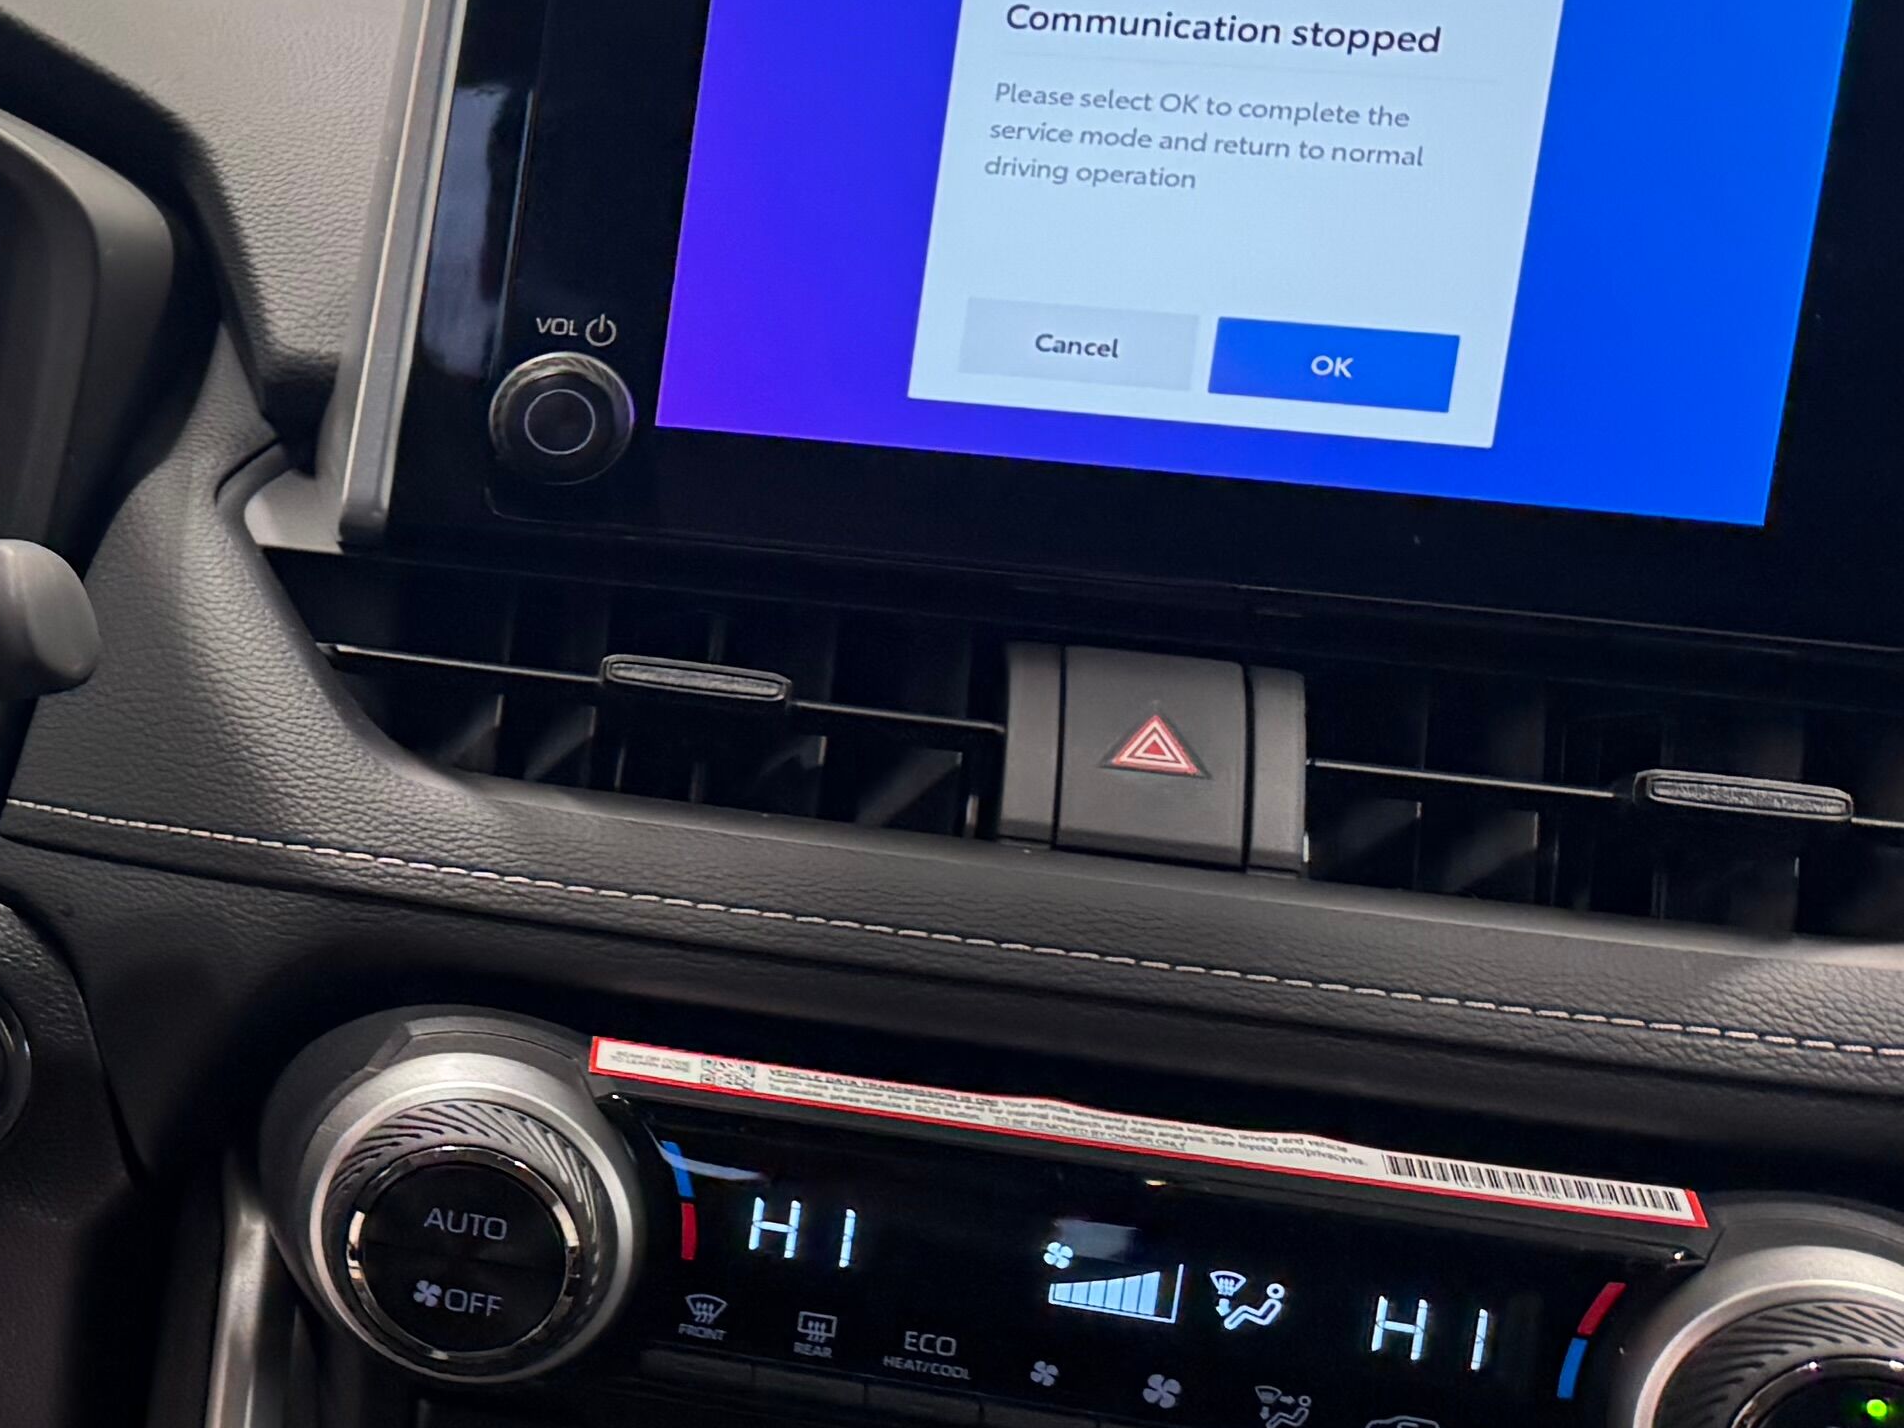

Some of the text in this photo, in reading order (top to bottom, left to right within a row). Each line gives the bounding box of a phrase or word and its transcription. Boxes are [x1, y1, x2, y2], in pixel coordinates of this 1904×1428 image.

[1006, 3, 1442, 57] Communication stopped
[995, 82, 1410, 128] Please select OK to complete the
[990, 121, 1425, 168] service mode and return to normal
[984, 155, 1197, 189] driving operation
[536, 316, 578, 337] VOL
[1033, 331, 1120, 361] Cancel
[1309, 355, 1354, 379] OK
[423, 1206, 508, 1241] AUTO
[748, 1196, 857, 1269] HI
[444, 1288, 505, 1317] OFF
[903, 1330, 958, 1358] ECO
[1371, 1294, 1489, 1371] HI
[793, 1340, 833, 1359] REAR
[882, 1354, 972, 1382] HEAT/COOL
